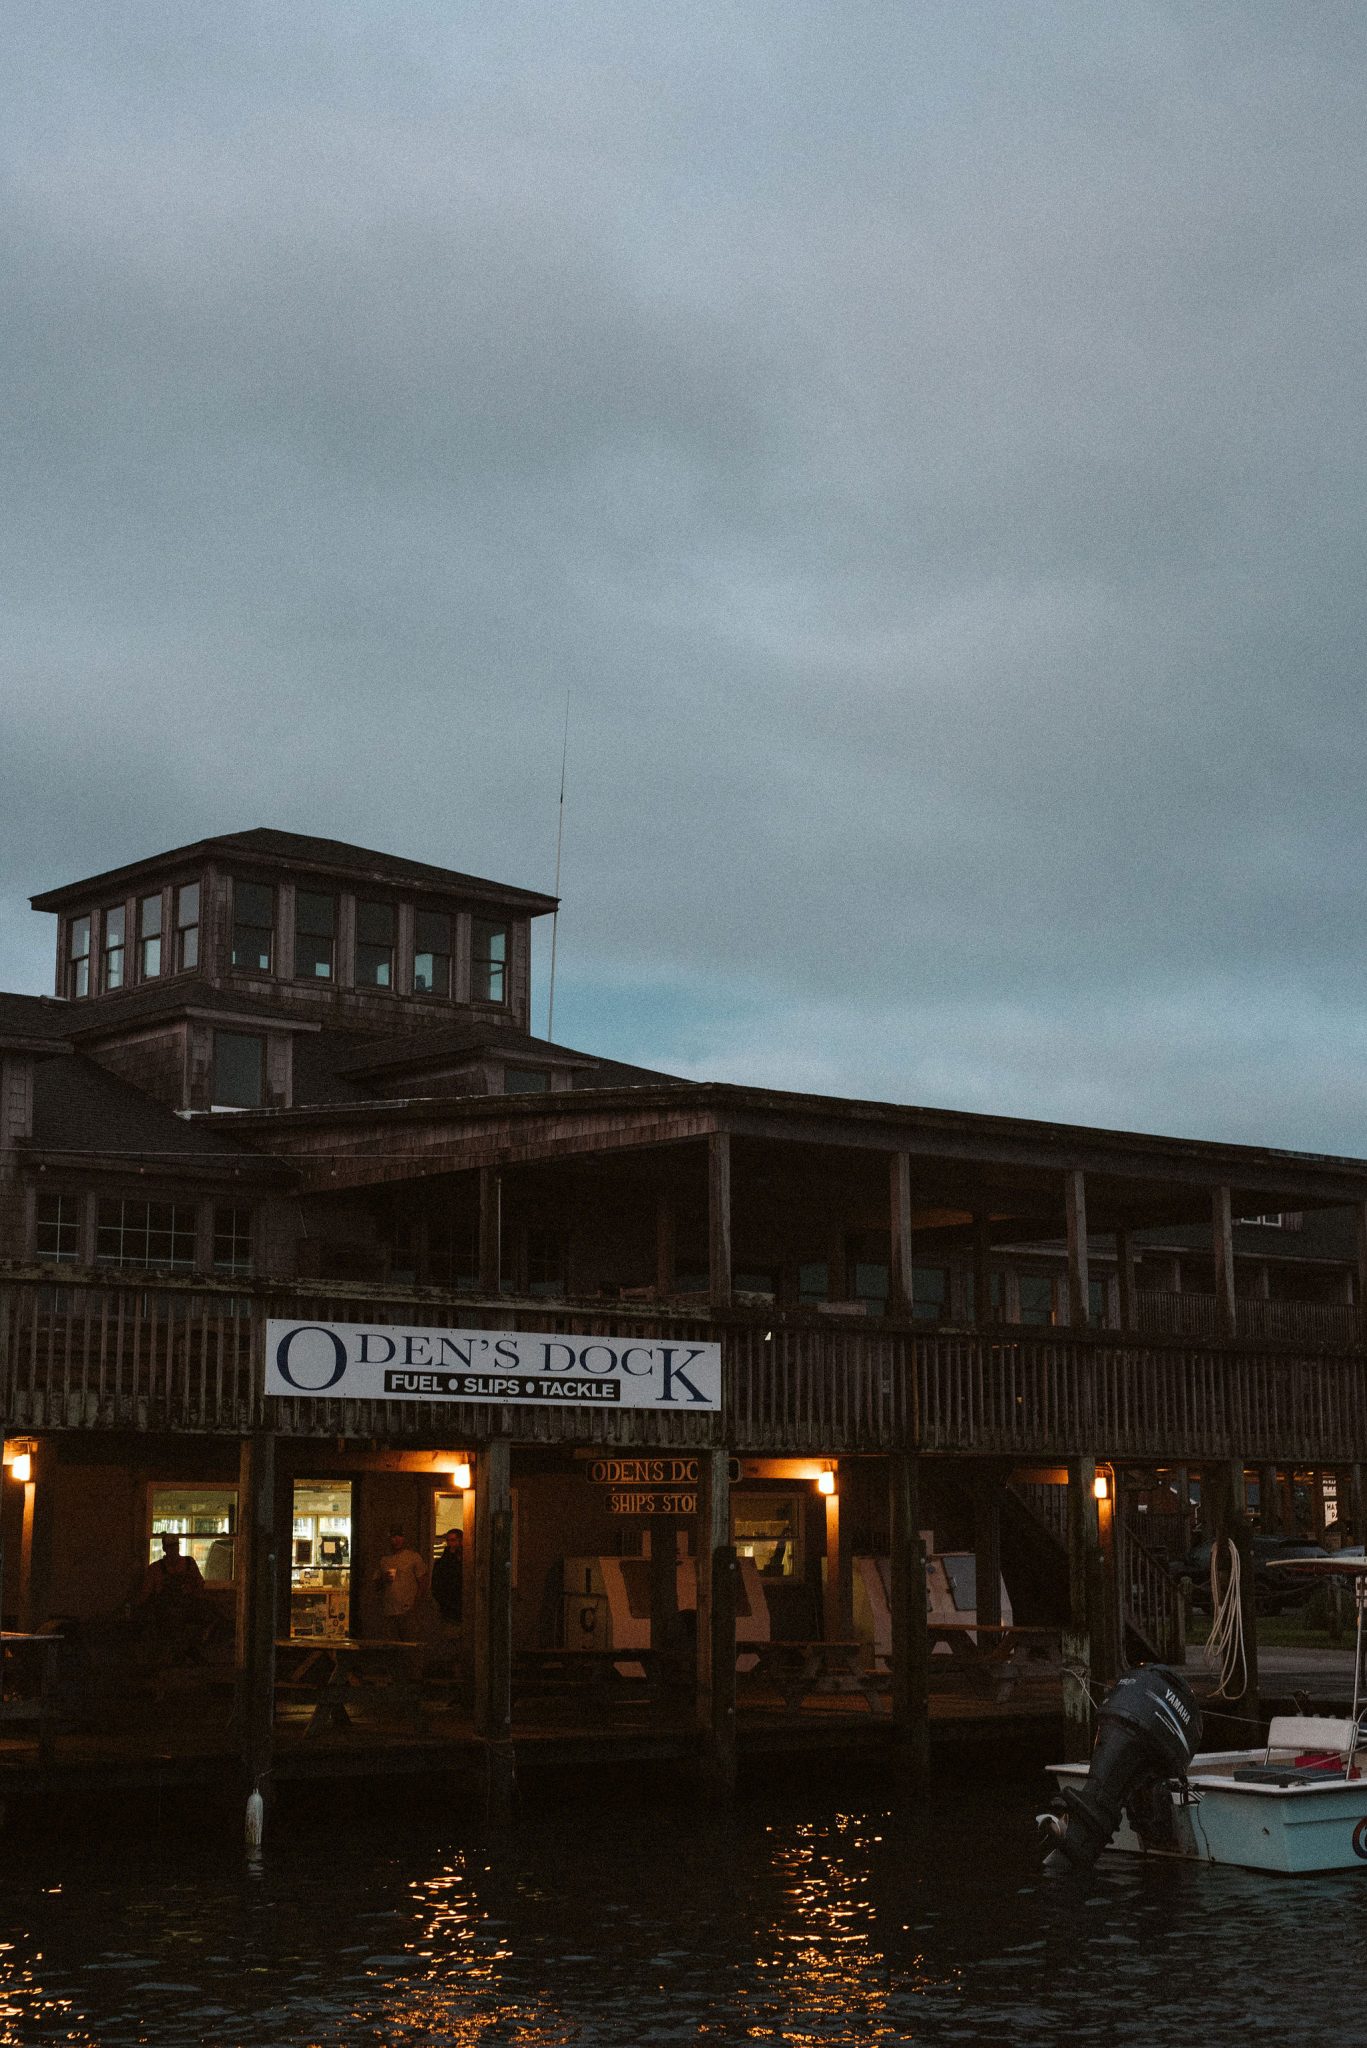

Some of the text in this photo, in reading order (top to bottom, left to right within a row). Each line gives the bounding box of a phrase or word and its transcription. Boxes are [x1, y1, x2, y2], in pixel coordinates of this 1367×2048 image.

[276, 1326, 712, 1403] ODEN'S DOCK
[391, 1374, 615, 1398] FUEL SLIPS TACKLE
[592, 1461, 699, 1481] ODEN'S DO
[611, 1495, 697, 1512] SHIP'S STO
[1165, 1688, 1191, 1725] YAMAHA
